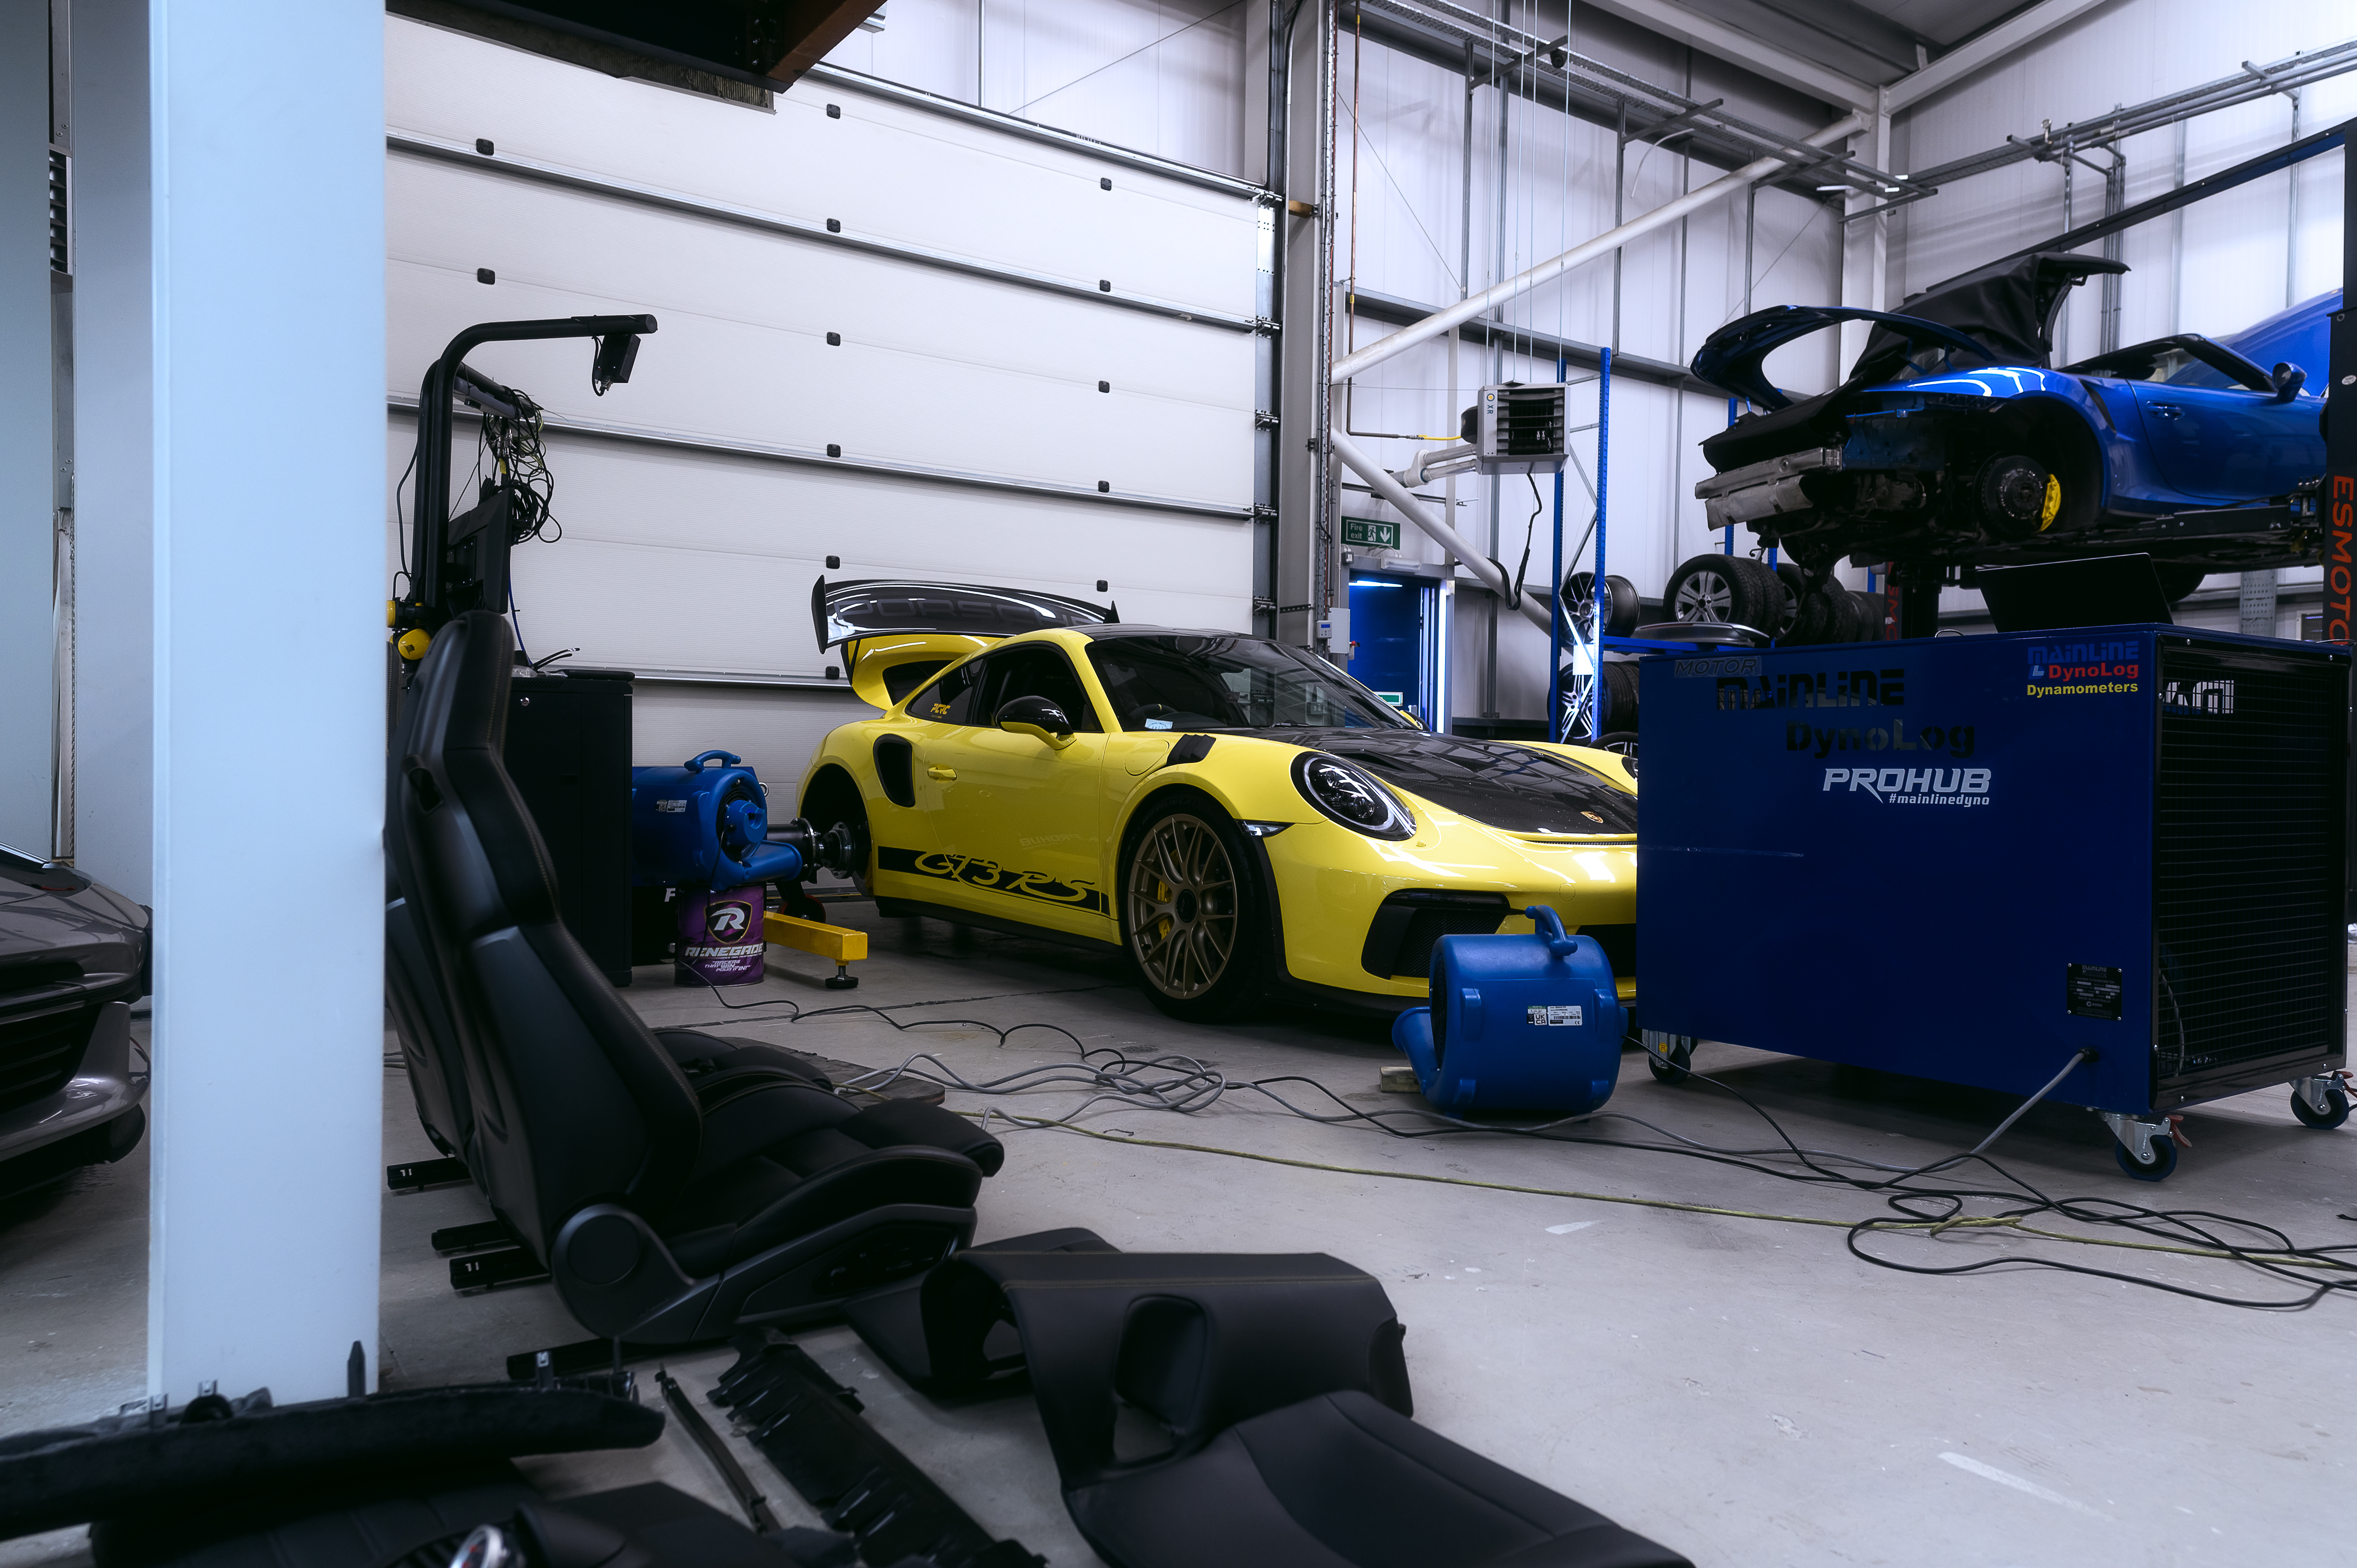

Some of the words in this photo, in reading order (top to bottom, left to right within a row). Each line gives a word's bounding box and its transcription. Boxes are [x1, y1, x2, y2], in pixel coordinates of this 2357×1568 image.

[1487, 404, 1494, 415] XR
[1351, 523, 1362, 531] Fire
[1675, 657, 1758, 676] MOTOR
[2049, 663, 2139, 682] DynoLog
[2027, 682, 2138, 698] Dynamometers
[1786, 719, 1975, 759] DynoLog
[1823, 768, 1991, 804] PROHUB
[1889, 793, 1990, 807] #mainlinedyno
[915, 853, 1004, 885] GT3
[1005, 871, 1095, 902] RS
[709, 907, 745, 930] R
